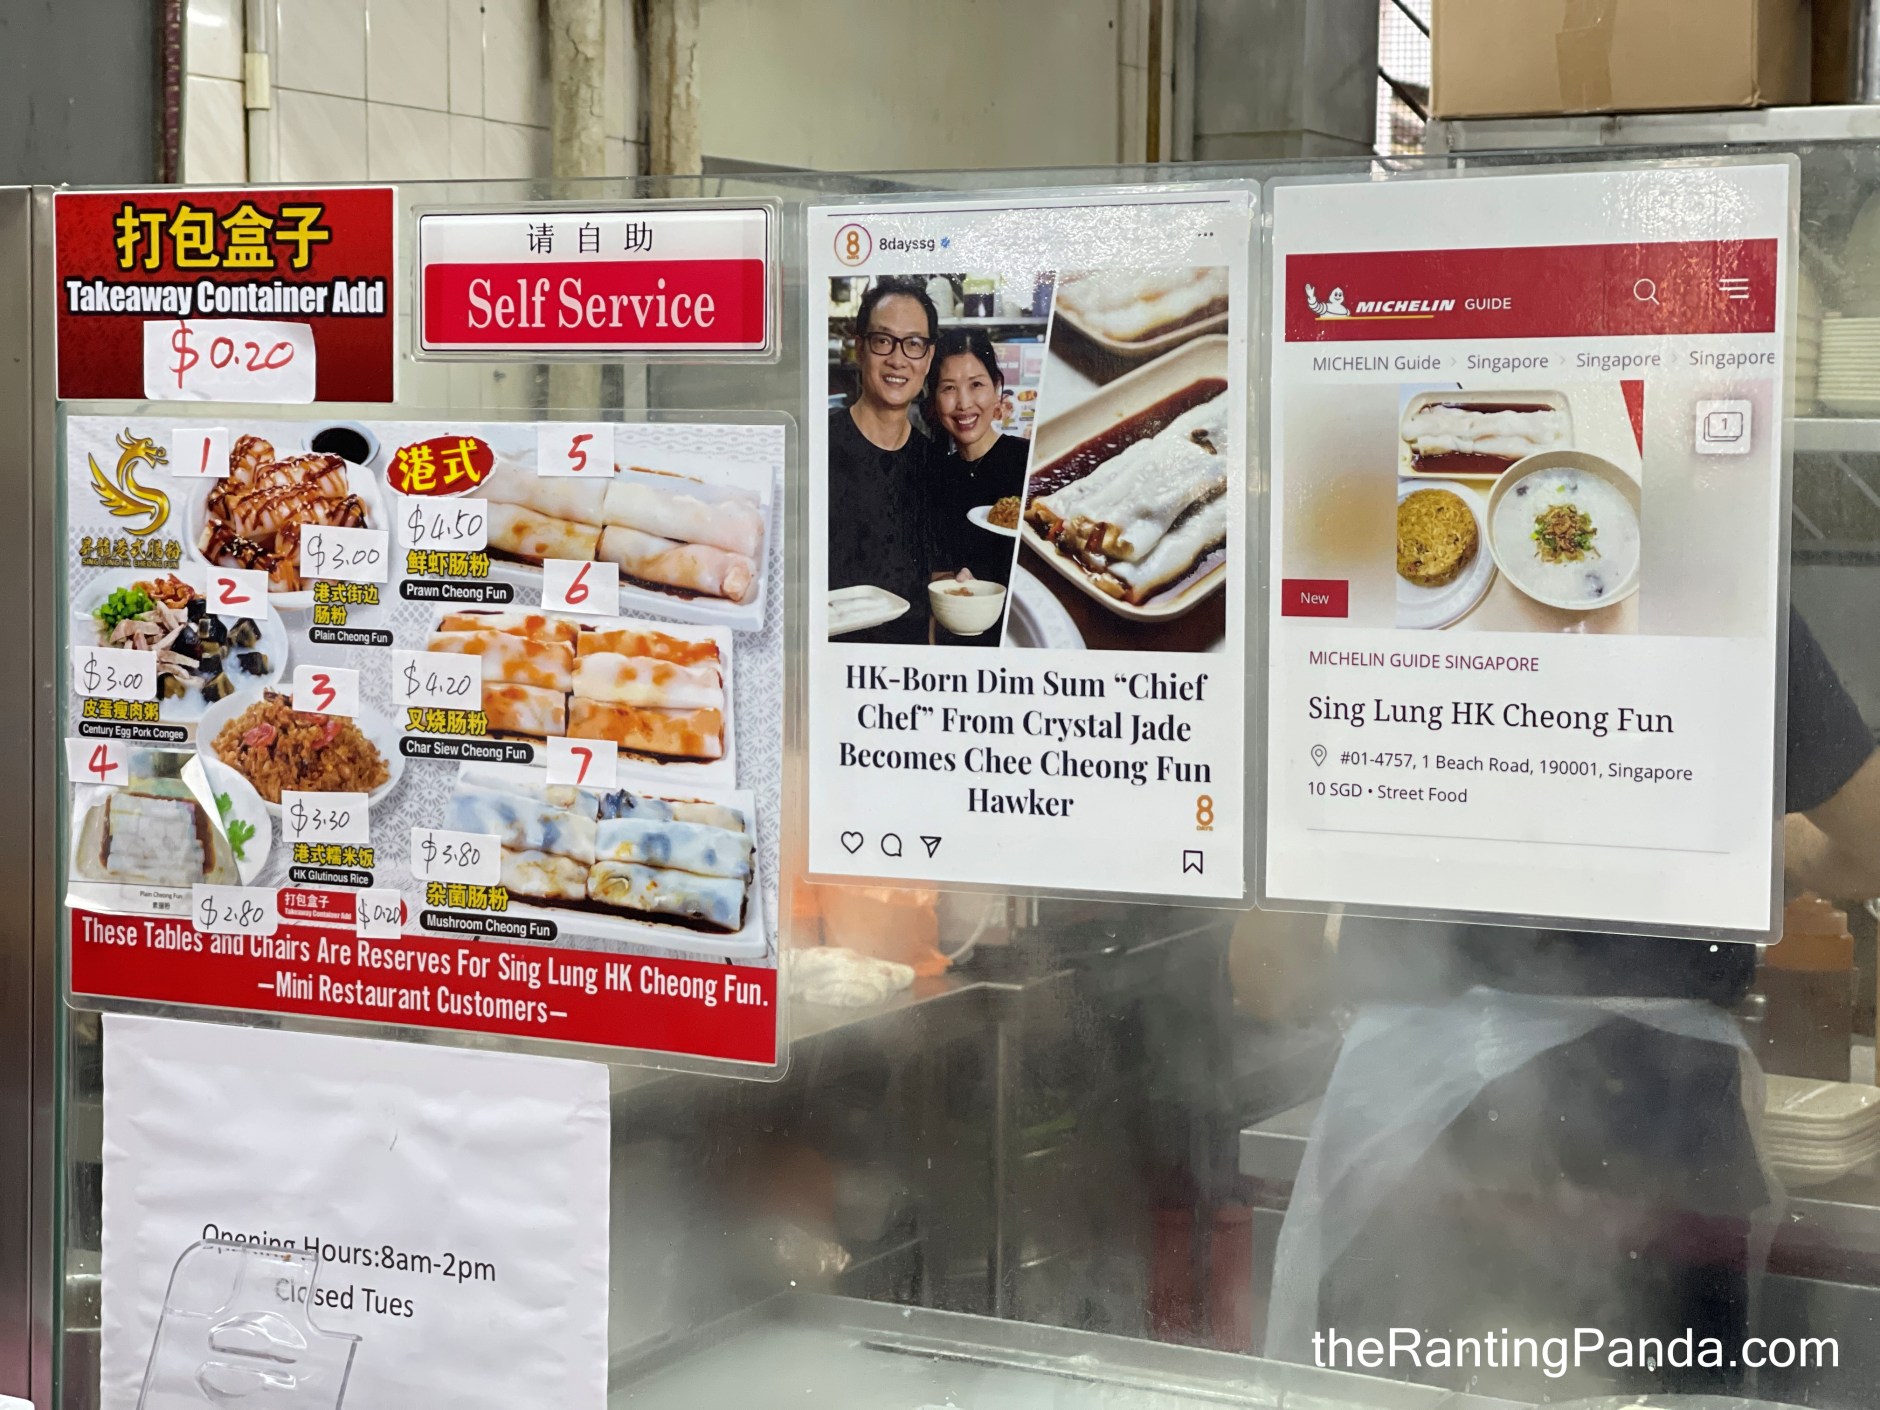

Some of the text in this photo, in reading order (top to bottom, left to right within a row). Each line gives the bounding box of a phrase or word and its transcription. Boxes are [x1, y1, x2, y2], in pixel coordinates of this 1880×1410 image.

[115, 204, 330, 269] 打包盒子
[526, 221, 653, 255] 请自助
[846, 230, 860, 255] 8
[879, 237, 935, 253] 8dayssg
[66, 281, 384, 316] Takeaway Container Add
[468, 277, 716, 329] Self Service
[1355, 297, 1512, 314] MICHELIN GUIDE
[1312, 349, 1776, 376] MICHELIN Guide Singapore Singapore Singapore
[1721, 417, 1728, 431] 1
[200, 436, 211, 473] 1
[396, 438, 482, 492] 港式
[567, 433, 594, 472] 5
[407, 503, 483, 546] $4.50
[306, 532, 381, 576] $3.00
[406, 549, 490, 578] 鲜虾肠粉
[217, 577, 251, 605] 2
[314, 582, 379, 605] 港式街边
[406, 583, 507, 602] Prawn Cheong Fun
[564, 561, 592, 605] 6
[1300, 591, 1330, 605] New
[314, 604, 347, 626] 肠粉
[314, 629, 388, 645] Plain Cheong Fun
[82, 651, 143, 694] $3.00
[1309, 650, 1539, 673] MICHELIN GUIDE SINGAPORE
[310, 673, 336, 711] 3
[403, 659, 471, 699] $4.20
[845, 664, 968, 694] HK-Born
[977, 667, 1034, 696] Dim
[1043, 670, 1106, 698] Sum
[83, 698, 160, 721] 皮蛋瘦肉粥
[405, 707, 488, 736] 叉烧肠粉
[1308, 695, 1674, 738] Sing Lung HK Cheong Fun
[82, 723, 184, 741] Century Egg Pork Congee
[941, 707, 1015, 736] From
[1022, 709, 1122, 743] Crystal
[1130, 713, 1192, 745] Jade
[88, 744, 119, 782] 4
[406, 739, 527, 761] Char Siew Cheong Fun
[570, 746, 593, 784] 7
[839, 742, 1212, 786] Becomes Chee Cheong Fun
[1340, 750, 1694, 785] #01-4757, 1 Beach Road, 190001, Singapore
[967, 787, 1075, 818] Hawker
[1308, 781, 1468, 803] 10 SGD Street Food
[290, 798, 351, 838] $3.30
[1196, 794, 1214, 826] 8
[294, 842, 375, 868] 港式糯米饭
[421, 832, 481, 874] $3.80
[293, 868, 369, 885] HK Glutinous Rice
[200, 895, 264, 930] $2.80
[284, 892, 330, 909] 打包盒子
[426, 881, 509, 912] 杂菌肠粉
[426, 913, 551, 937] Mushroom Cheong Fun
[82, 915, 769, 1008] These Tables and Chairs Are Reserves For Sing Lung HK Cheong Fun.
[318, 974, 431, 1013] Restaurant
[361, 1287, 414, 1318] Tues
